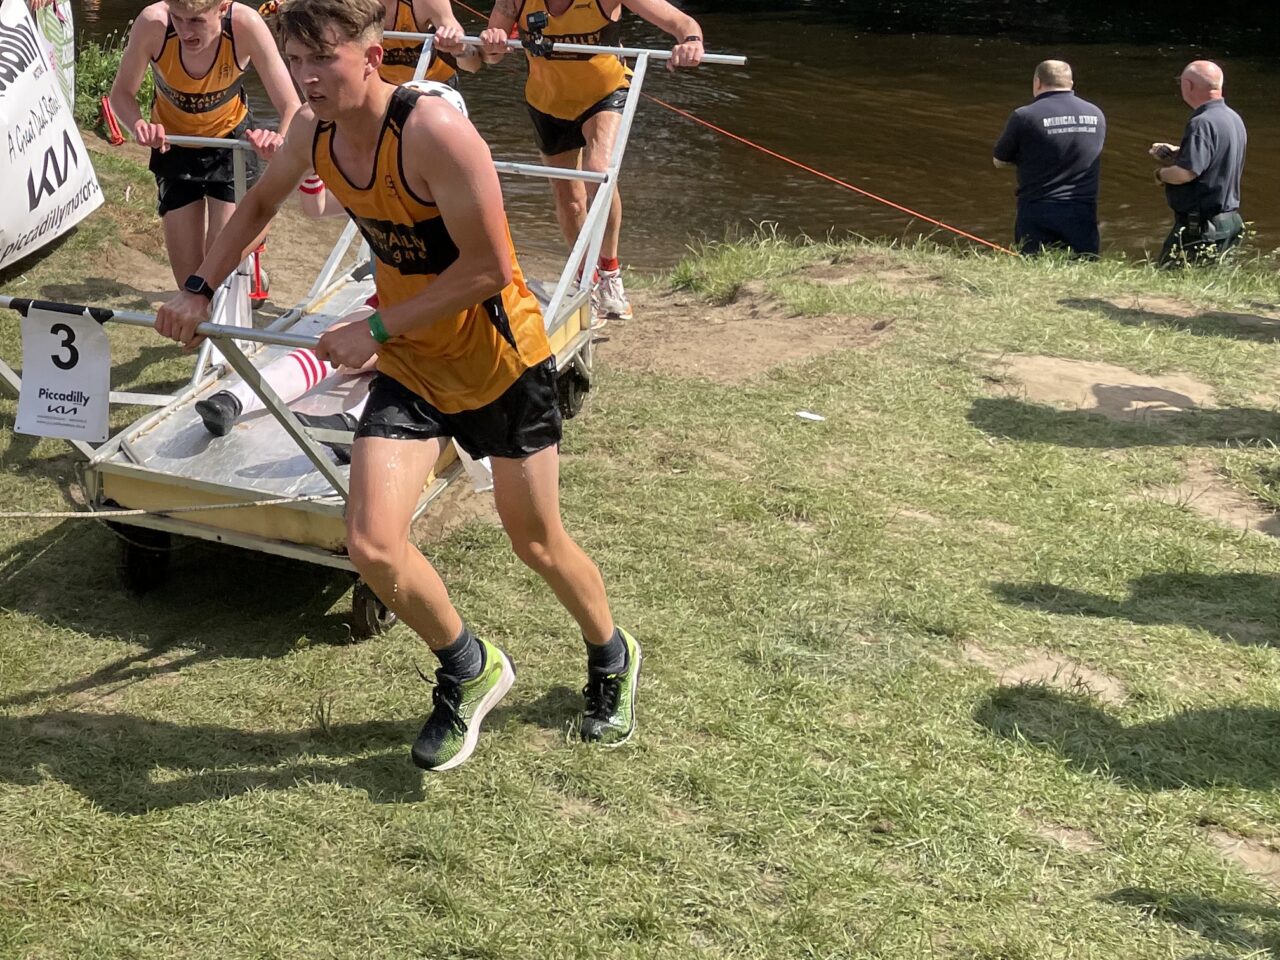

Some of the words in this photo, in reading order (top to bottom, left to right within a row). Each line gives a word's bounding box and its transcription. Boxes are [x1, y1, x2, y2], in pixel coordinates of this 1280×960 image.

[1042, 115, 1077, 128] MEDICAL
[7, 129, 17, 164] A
[27, 128, 78, 213] KIA
[50, 323, 79, 370] 3
[38, 387, 90, 407] Piccadilly
[47, 404, 78, 415] KIA
